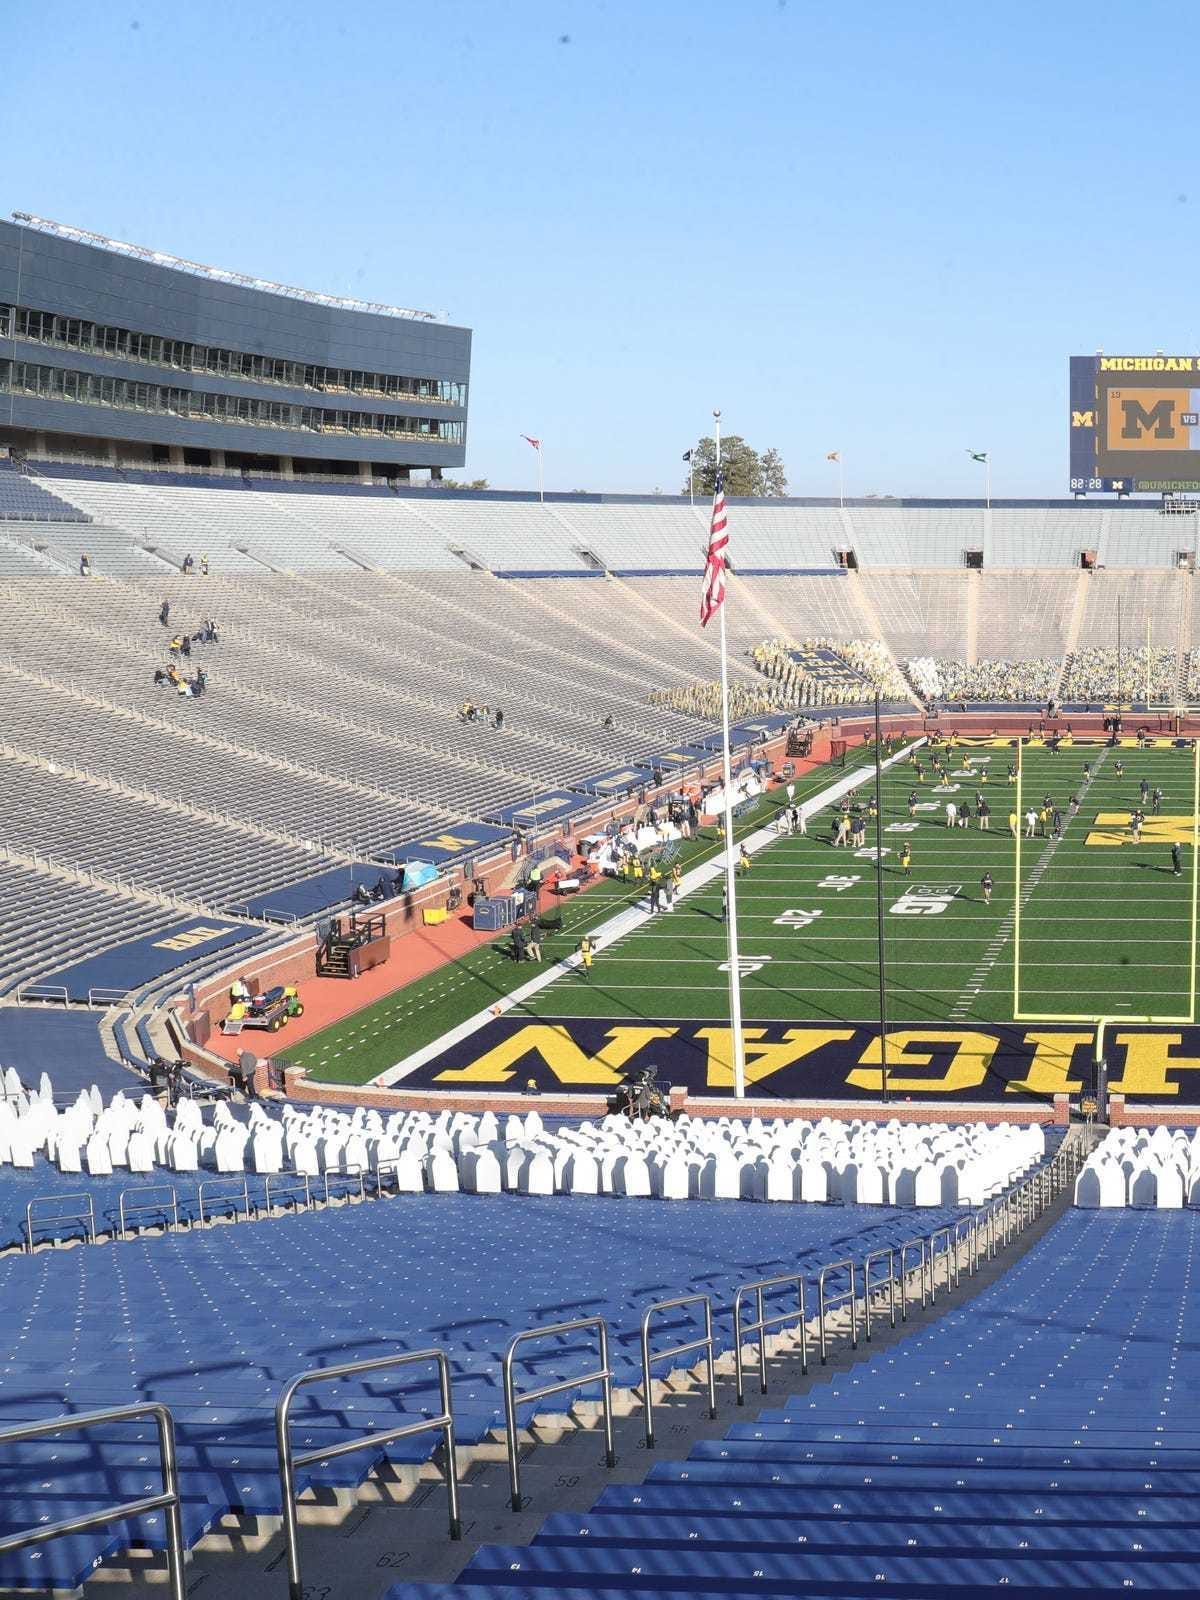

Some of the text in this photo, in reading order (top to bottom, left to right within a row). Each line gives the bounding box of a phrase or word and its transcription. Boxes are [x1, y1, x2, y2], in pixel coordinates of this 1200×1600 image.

[1100, 358, 1192, 371] MICHIGAN
[1072, 411, 1093, 427] M
[1121, 400, 1175, 439] M
[1183, 415, 1197, 424] VS
[1112, 481, 1123, 489] M
[772, 909, 823, 925] 20
[375, 1551, 410, 1568] 62
